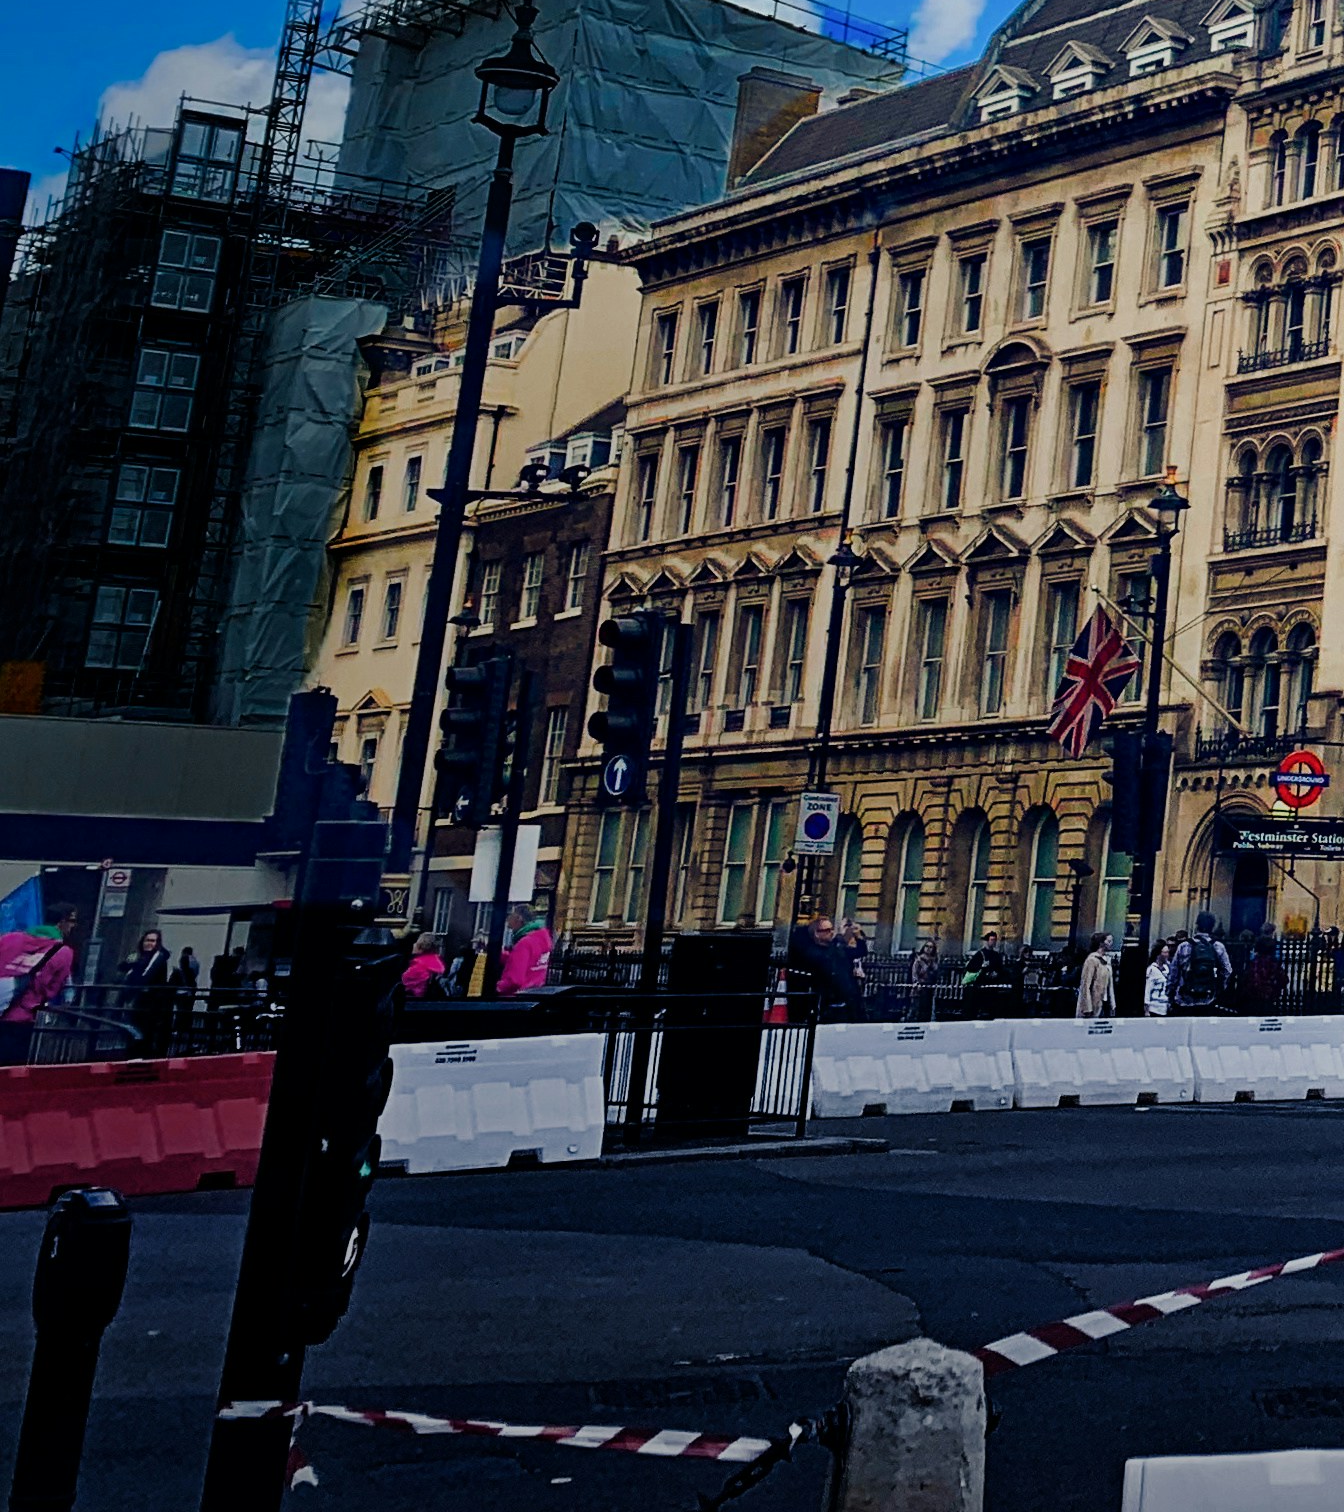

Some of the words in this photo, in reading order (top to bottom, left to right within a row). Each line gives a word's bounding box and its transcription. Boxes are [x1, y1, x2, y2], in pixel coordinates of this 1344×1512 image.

[1277, 775, 1325, 783] UNDERGROUND
[807, 802, 833, 812] ZONE
[1239, 830, 1309, 843] Westminster
